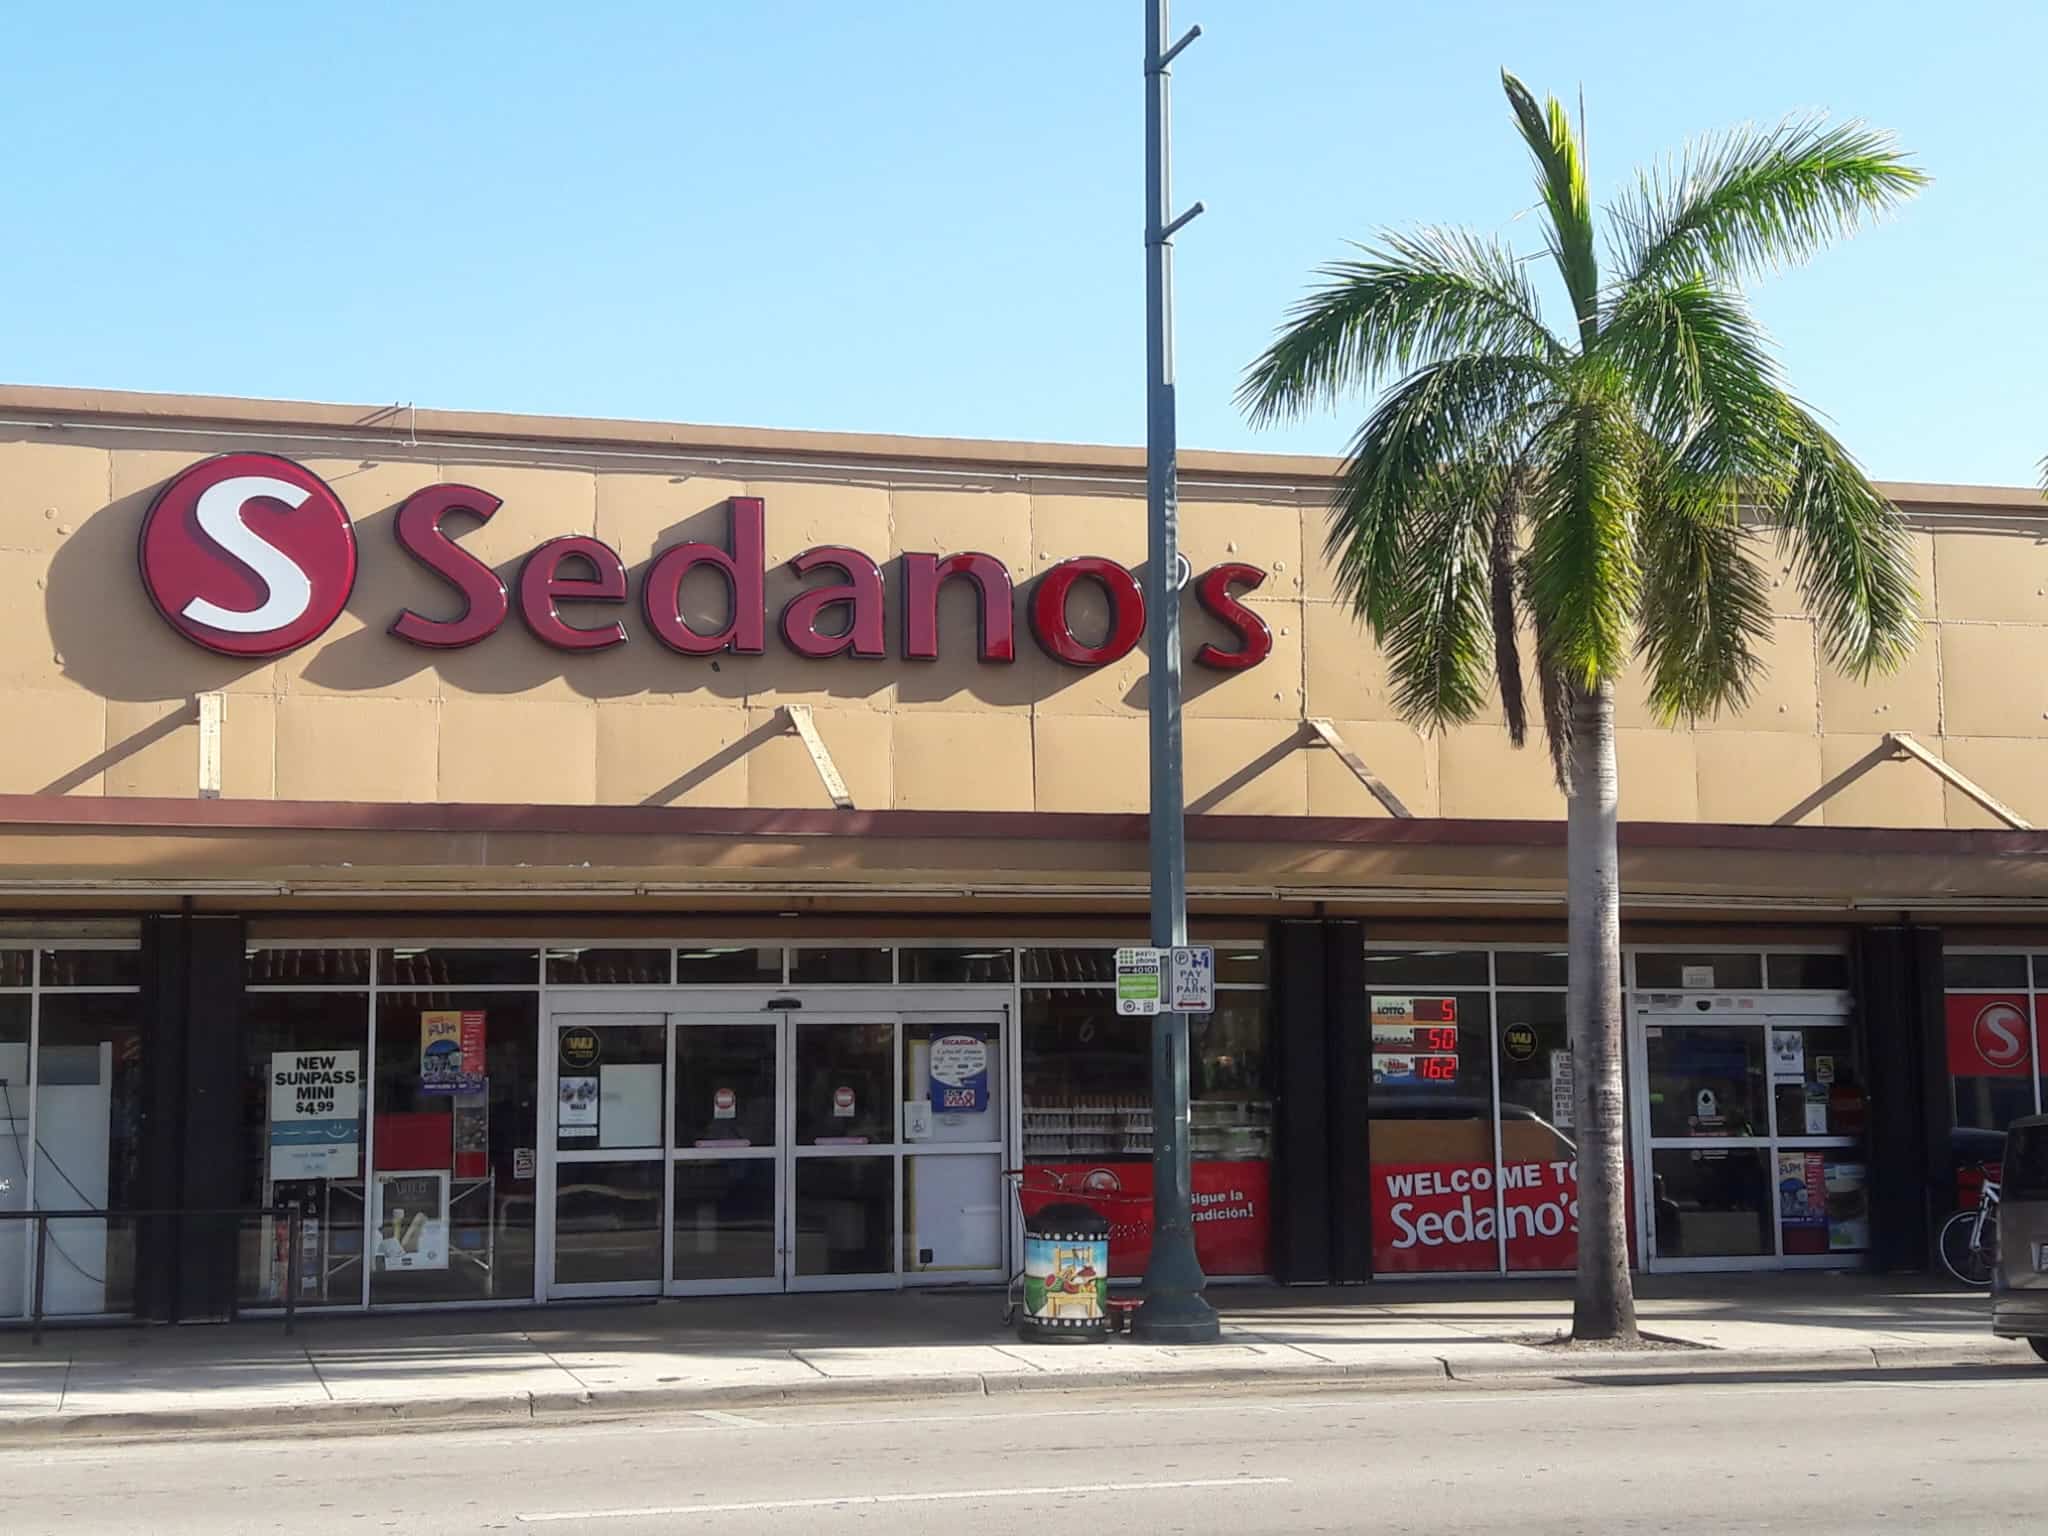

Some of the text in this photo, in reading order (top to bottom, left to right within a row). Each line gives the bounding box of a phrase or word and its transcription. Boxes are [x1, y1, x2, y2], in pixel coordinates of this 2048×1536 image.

[1377, 1006, 1405, 1015] LOTTO
[1441, 999, 1454, 1021] 5
[1428, 1028, 1455, 1050] 50
[296, 1056, 336, 1070] NEW
[1423, 1057, 1456, 1080] 162
[274, 1070, 356, 1086] SUNPASS
[296, 1086, 335, 1100] MINI
[295, 1101, 335, 1115] $4.99
[1386, 1164, 1543, 1198] WELCOME
[1230, 1189, 1243, 1201] la
[1191, 1202, 1254, 1222] radición!
